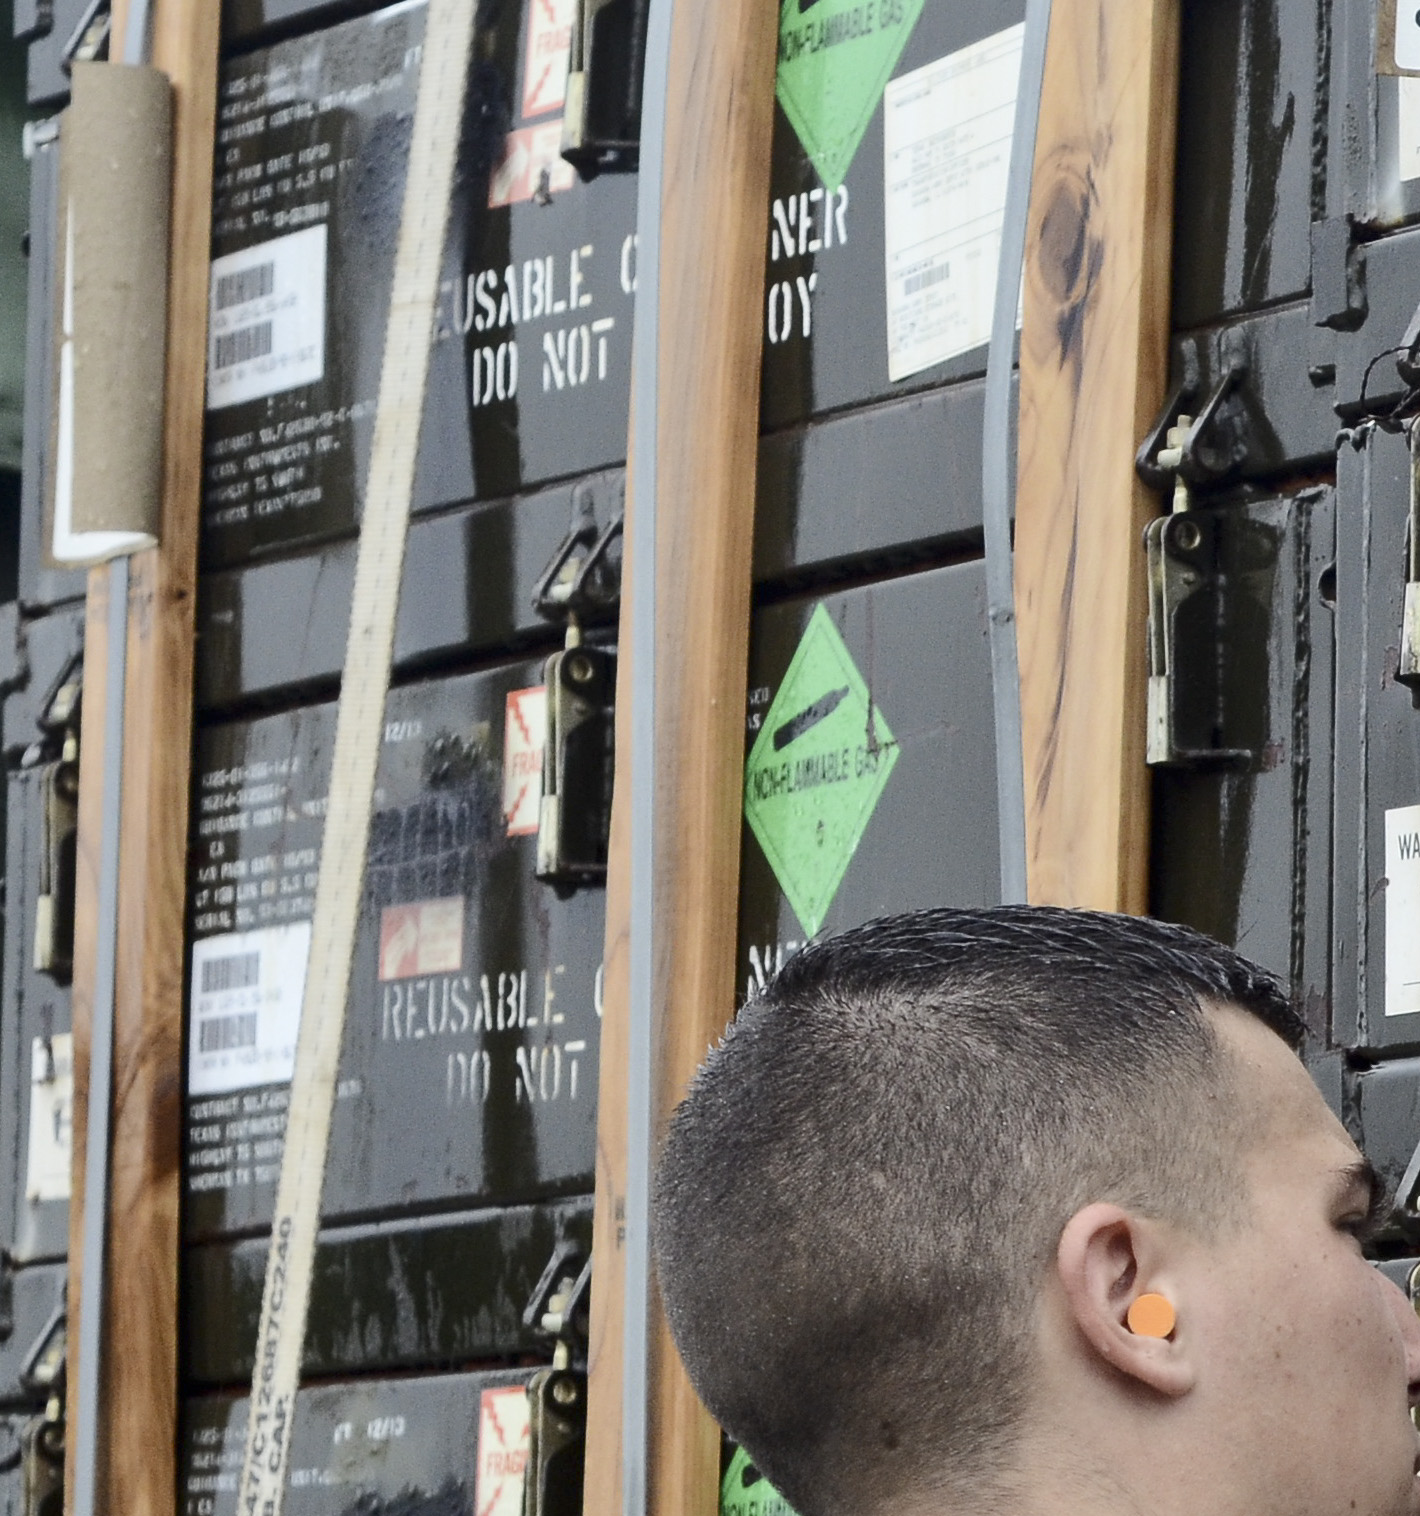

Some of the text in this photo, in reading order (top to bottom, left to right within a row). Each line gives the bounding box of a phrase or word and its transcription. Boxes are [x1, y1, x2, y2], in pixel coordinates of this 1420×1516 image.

[772, 184, 848, 260] NER
[768, 272, 818, 344] OY
[473, 317, 614, 407] DO NOT
[382, 965, 565, 1041] REUSABLE
[447, 1040, 586, 1103] DO NOT
